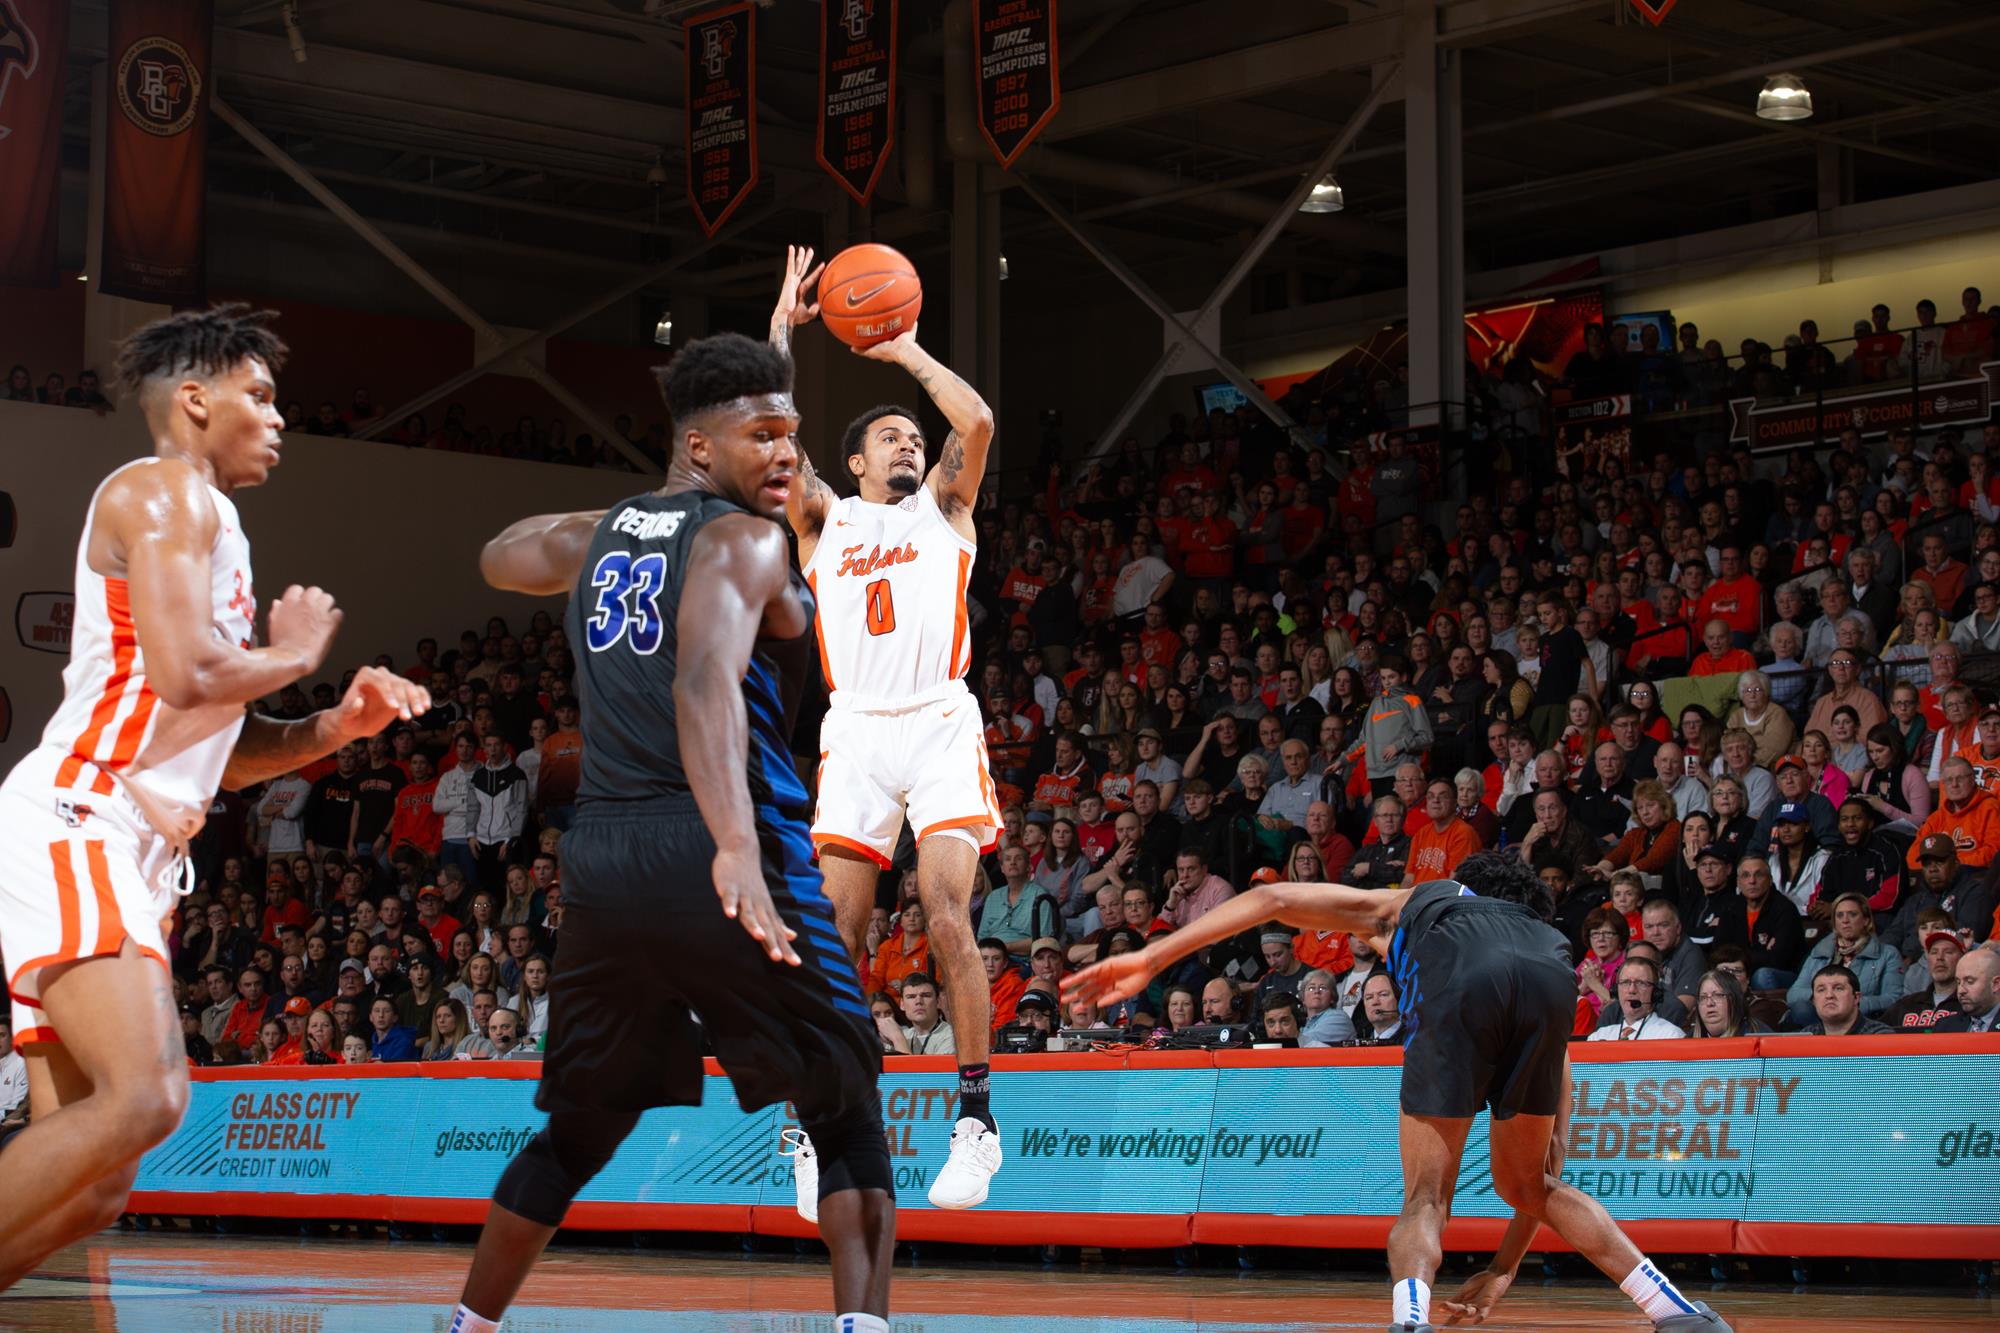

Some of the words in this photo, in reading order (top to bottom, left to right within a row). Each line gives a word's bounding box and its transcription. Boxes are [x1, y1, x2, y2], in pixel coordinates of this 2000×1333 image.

[984, 9, 1042, 32] BASKETBALL
[993, 27, 1031, 50] MAC
[832, 49, 886, 71] BASKETBALL
[982, 48, 1012, 64] REGULAR
[1012, 41, 1046, 57] SEASON
[982, 52, 1046, 79] CHAMPIONS
[840, 67, 877, 89] MAC
[995, 72, 1028, 94] 1997
[827, 92, 887, 117] CHAMPIONS
[828, 88, 861, 104] REGULAR
[994, 93, 1029, 114] 2000
[700, 105, 733, 126] MAC
[994, 113, 1029, 135] 2009
[692, 129, 746, 152] CHAMPIONS
[1593, 401, 1609, 416] 102
[1872, 400, 1933, 421] CORNR
[1014, 581, 1043, 595] BEAT
[587, 551, 667, 655] 33
[866, 579, 896, 636] 0
[231, 1092, 303, 1120] GLASS
[305, 1092, 361, 1120] CITY
[887, 1088, 960, 1120] CITY
[1571, 1078, 1687, 1116] LASS
[1695, 1076, 1800, 1115] CITY
[225, 1123, 326, 1150] FEDERAL
[1020, 1128, 1092, 1157] We're
[1099, 1128, 1205, 1165] working
[1210, 1127, 1254, 1158] for
[1254, 1127, 1323, 1167] you!
[1567, 1121, 1741, 1159] EDERAL
[219, 1157, 276, 1177] CREDIT
[280, 1158, 331, 1178] UNION
[1560, 1171, 1646, 1197] REDIT
[1656, 1171, 1756, 1197] UNION
